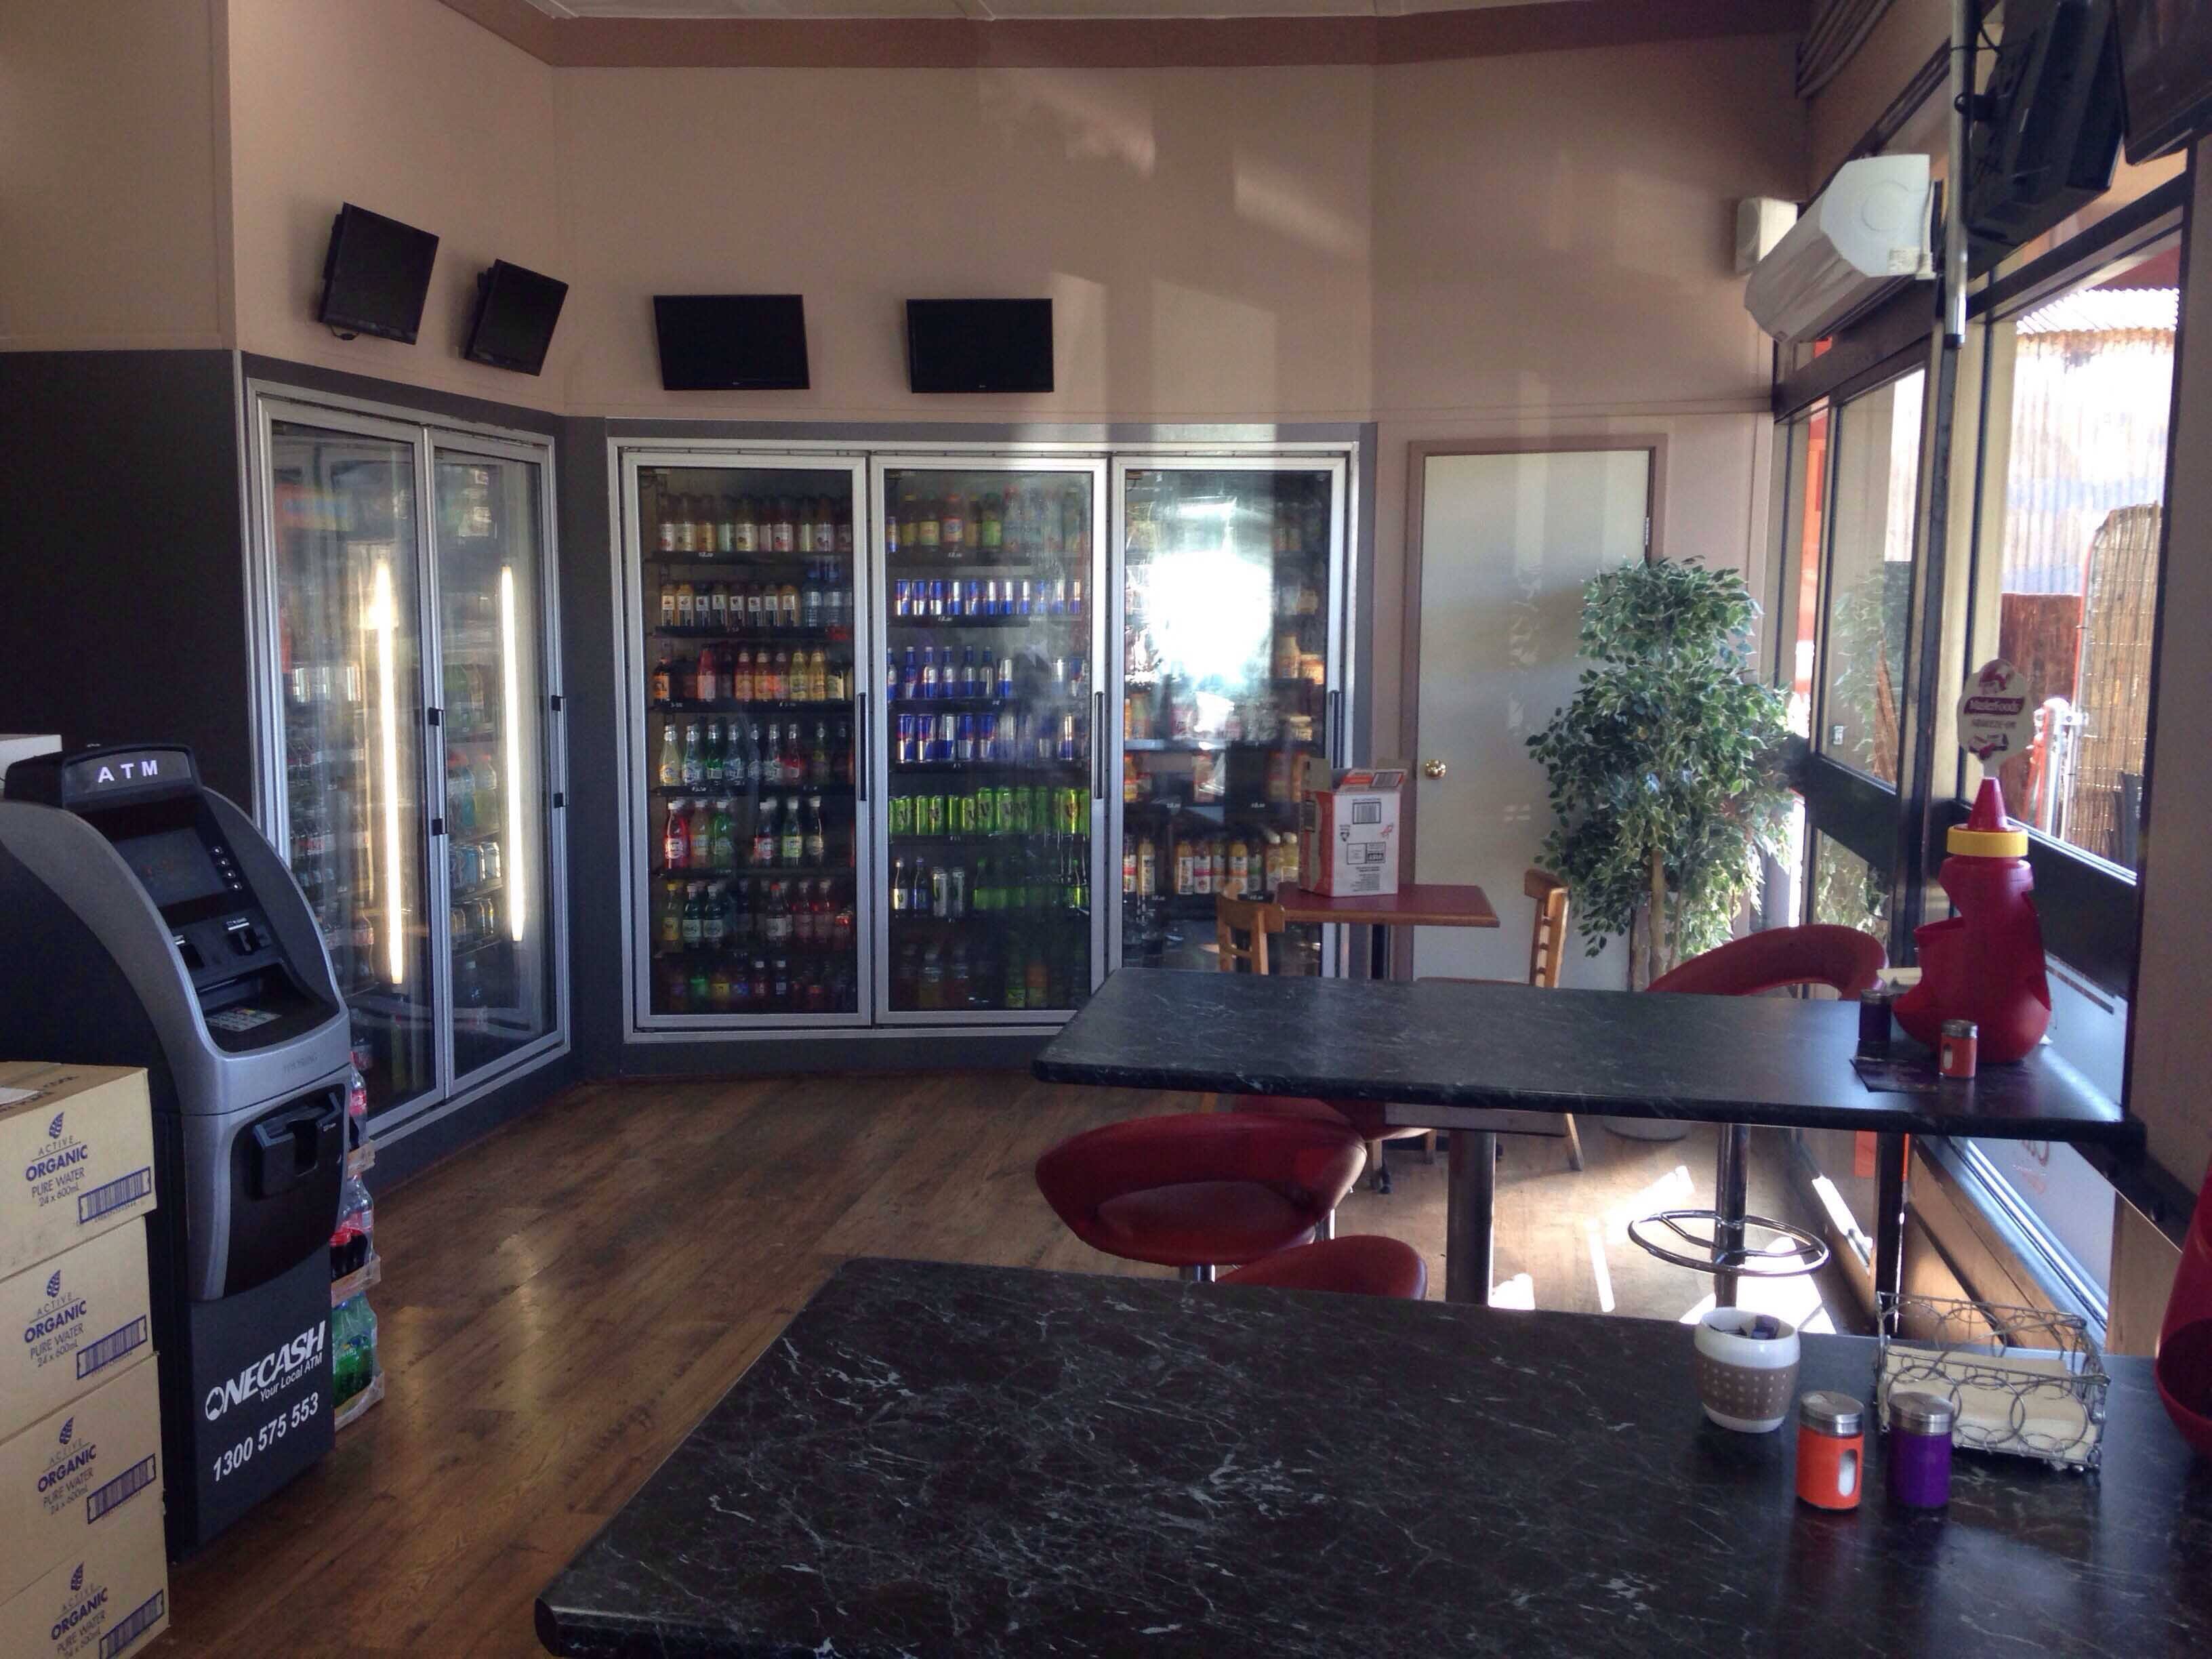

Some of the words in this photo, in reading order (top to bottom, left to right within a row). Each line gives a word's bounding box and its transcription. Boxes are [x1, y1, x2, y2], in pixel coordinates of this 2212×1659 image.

[98, 760, 158, 783] ATM
[26, 1144, 88, 1181] ORGANIC
[38, 1135, 73, 1156] ACTIVE
[32, 1179, 53, 1198] PURE
[56, 1167, 85, 1187] WATER
[39, 1196, 49, 1207] 24
[24, 1300, 87, 1343] ORGANIC
[37, 1292, 73, 1316] ACTIVE
[30, 1339, 52, 1359] PURE
[54, 1323, 84, 1345] WATER
[38, 1357, 48, 1368] 24
[205, 1320, 326, 1421] ONECASH
[260, 1383, 280, 1403] Your
[281, 1366, 303, 1389] Local
[304, 1353, 323, 1374] ATM
[213, 1437, 253, 1481] 1300
[258, 1413, 287, 1452] 575
[291, 1392, 319, 1428] 553
[38, 1444, 96, 1492] ORGANIC
[43, 1486, 64, 1508] PURE
[66, 1467, 94, 1492] WATER
[52, 1586, 108, 1640] ORGANIC
